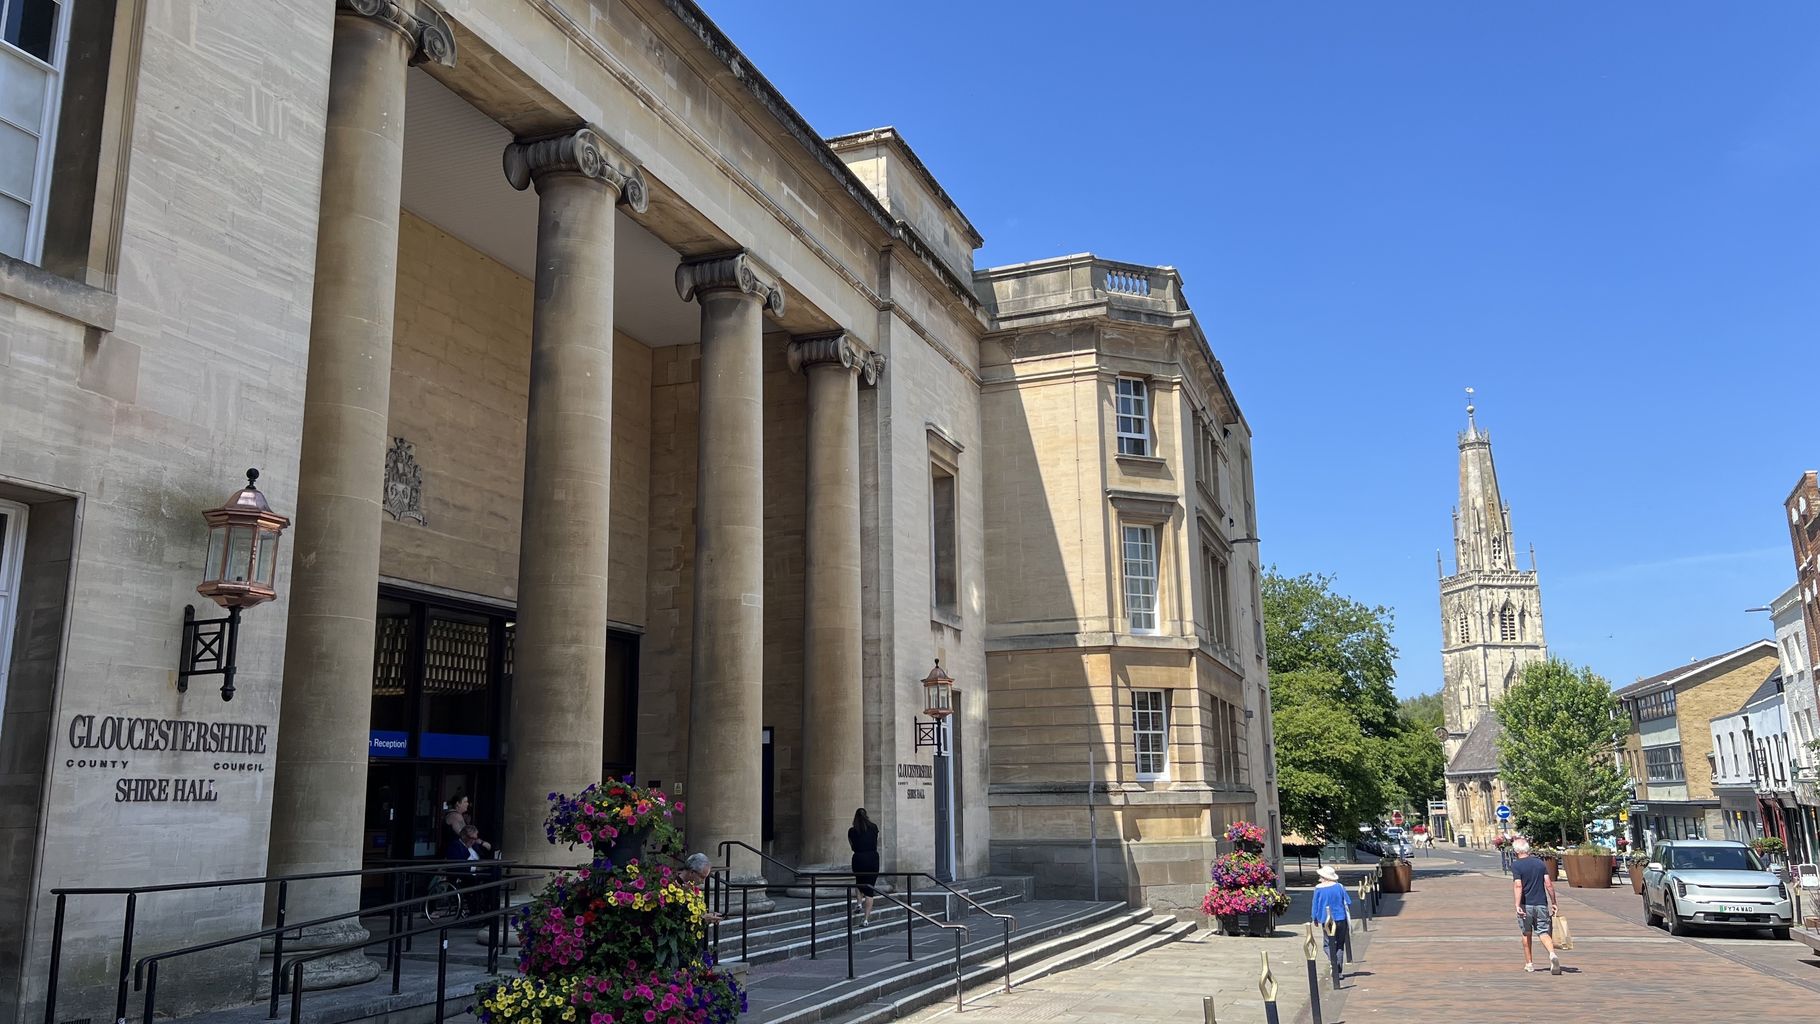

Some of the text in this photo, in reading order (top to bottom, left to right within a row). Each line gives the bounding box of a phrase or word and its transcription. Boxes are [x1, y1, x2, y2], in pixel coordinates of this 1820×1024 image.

[69, 714, 267, 754] GLOUCESTERSHIRE
[66, 759, 265, 772] COUNTY COUNCIL
[115, 778, 218, 802] SHIRE HALL
